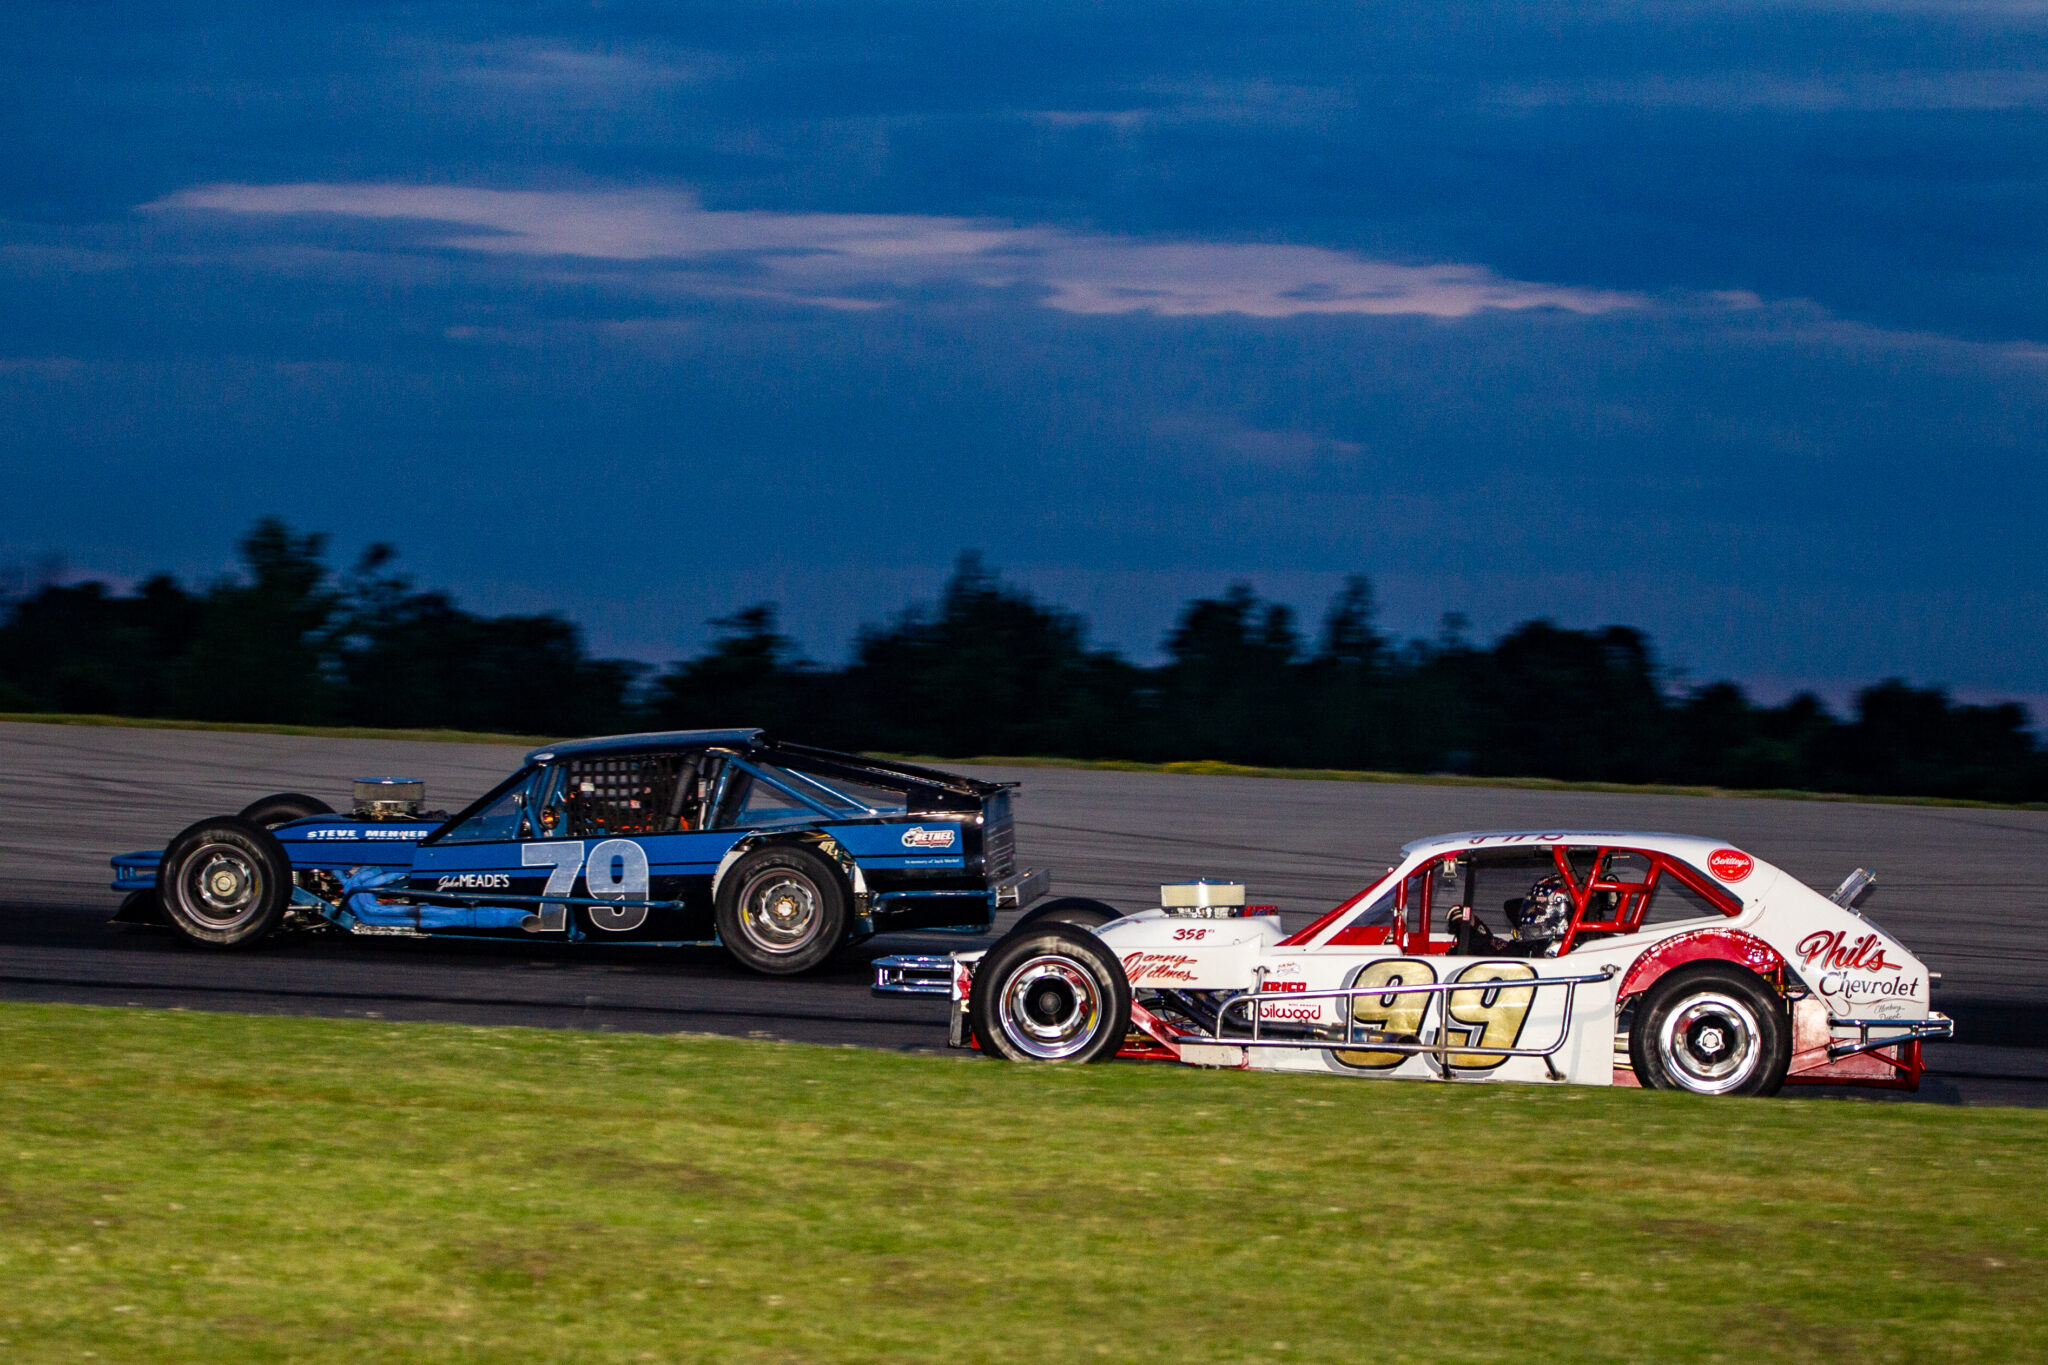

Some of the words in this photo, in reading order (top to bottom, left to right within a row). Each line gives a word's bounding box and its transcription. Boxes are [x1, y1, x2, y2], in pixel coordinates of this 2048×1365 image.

[307, 830, 358, 838] STEVE
[1711, 856, 1750, 868] Bentley's
[459, 873, 511, 888] MEADE'S
[521, 838, 650, 932] 79
[1173, 928, 1207, 941] 358
[1796, 930, 1903, 972] Phil's
[1819, 971, 1920, 999] Chevrolet
[1322, 957, 1540, 1077] 99
